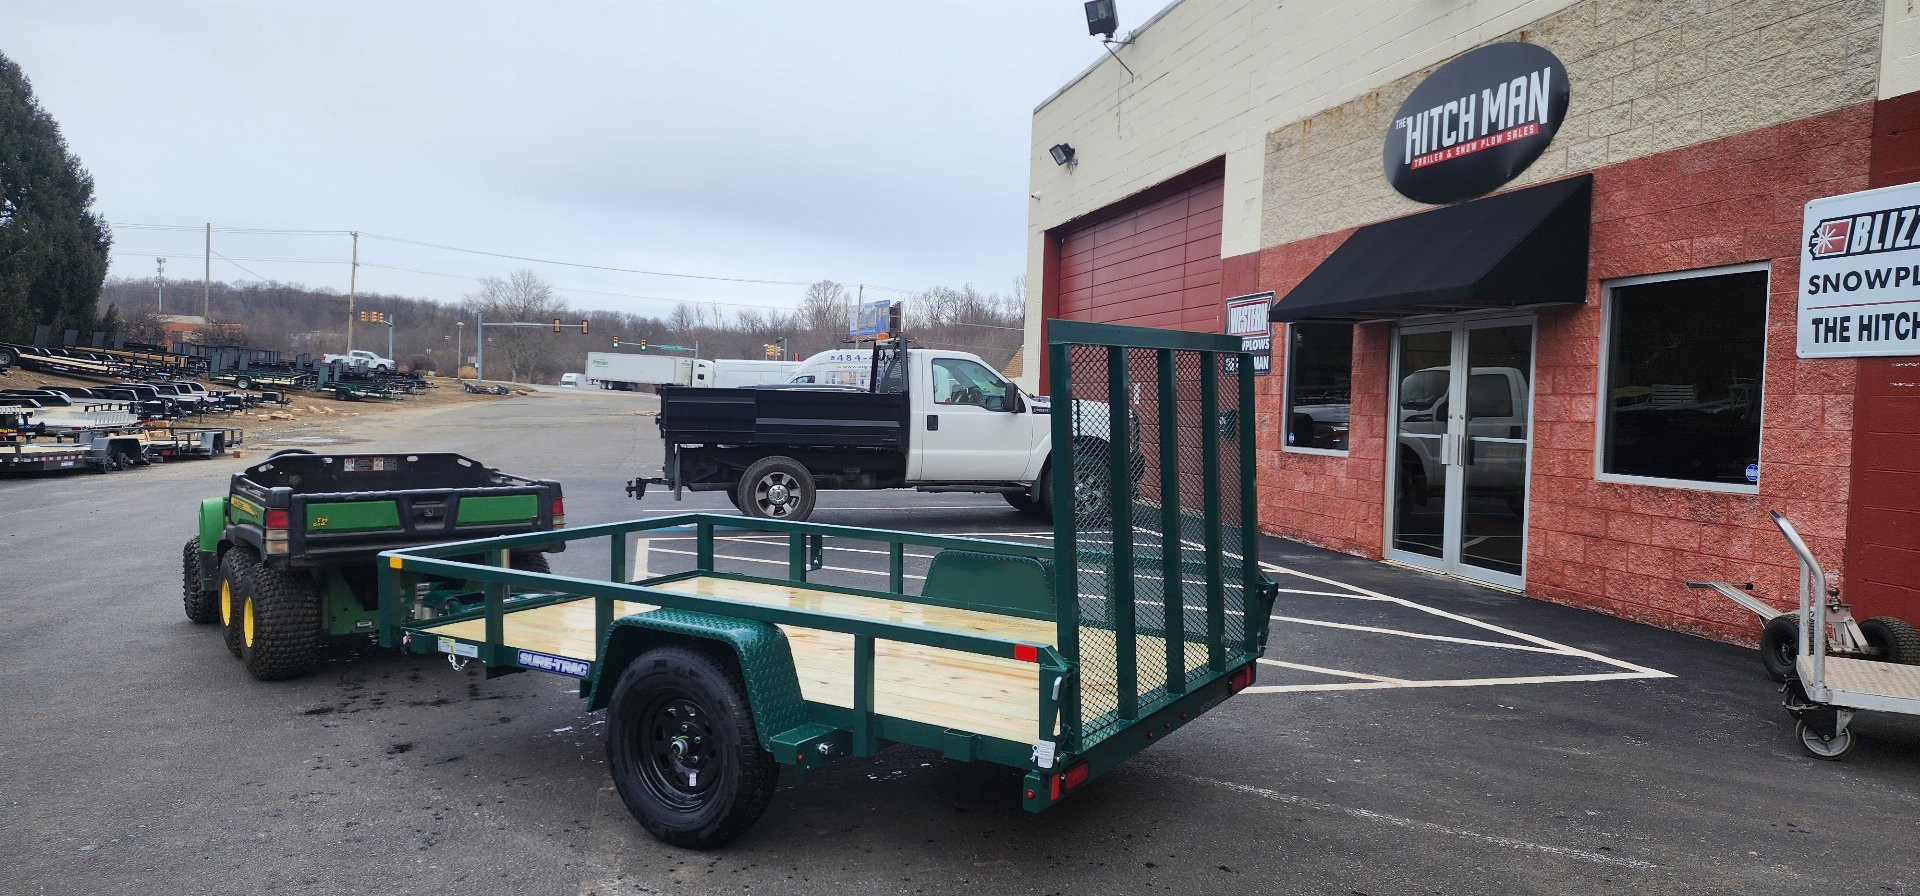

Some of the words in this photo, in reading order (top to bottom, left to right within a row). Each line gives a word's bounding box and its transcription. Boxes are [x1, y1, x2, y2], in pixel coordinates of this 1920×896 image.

[1396, 117, 1408, 130] THE
[1405, 93, 1476, 164] HITCH
[1481, 66, 1551, 136] MAN
[1414, 152, 1443, 168] TRAILER
[1455, 142, 1477, 156] SNOW
[1481, 134, 1503, 148] PLOW
[1507, 124, 1535, 140] SALES
[1230, 302, 1267, 335] WESTERN
[1811, 315, 1850, 344] THE
[1858, 311, 1920, 342] HITCH
[519, 652, 588, 677] SURE-TRAC
